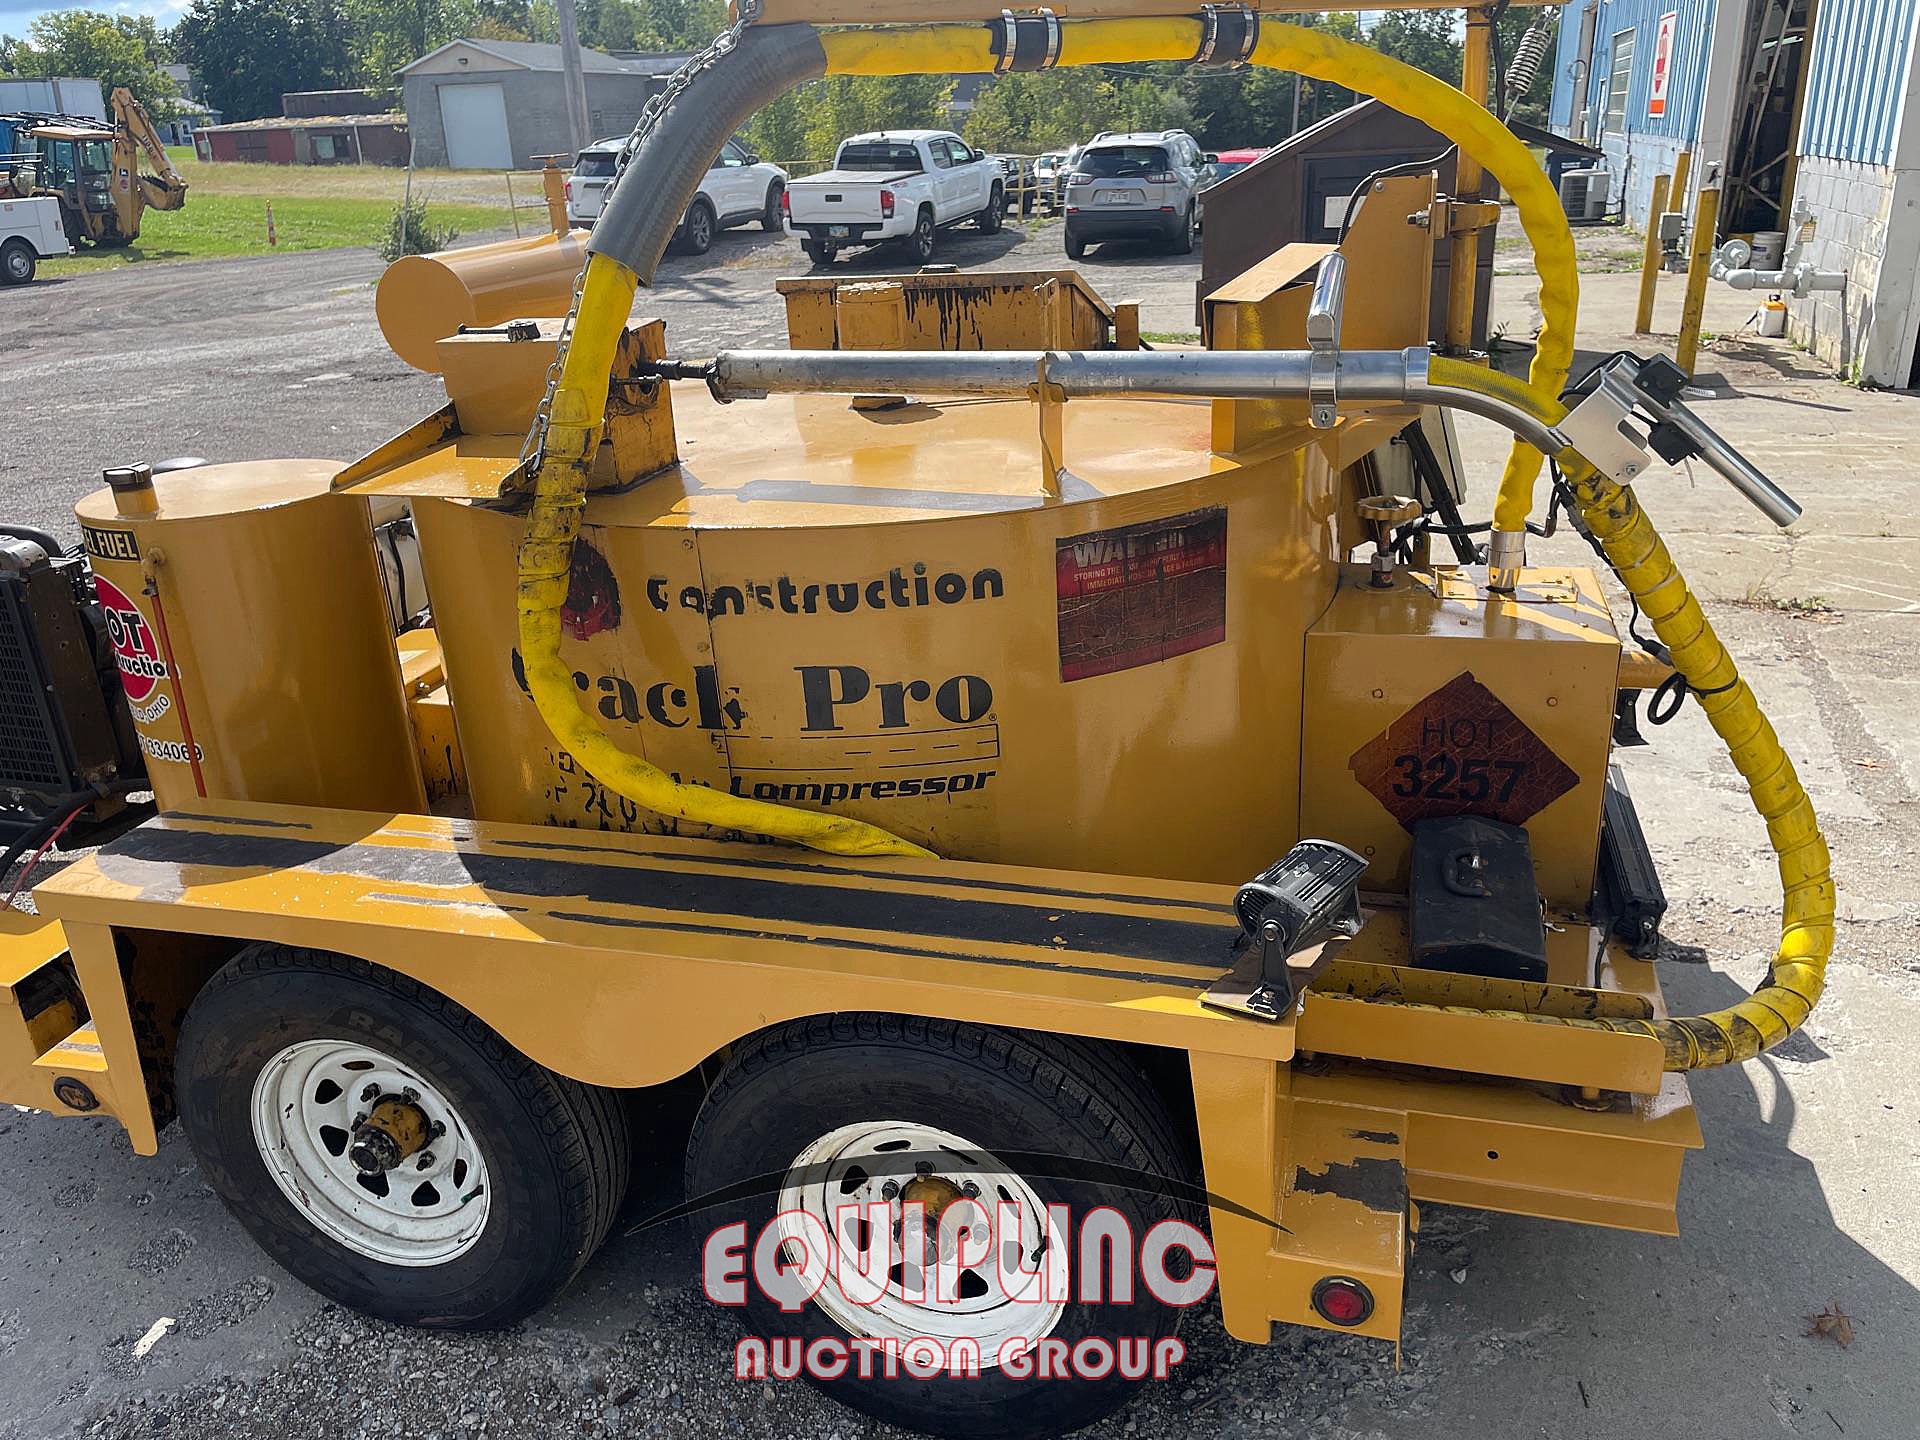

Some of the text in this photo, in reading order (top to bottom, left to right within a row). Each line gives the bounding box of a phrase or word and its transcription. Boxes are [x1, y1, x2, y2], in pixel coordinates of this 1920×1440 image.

[96, 532, 138, 558] FUEL
[148, 695, 170, 719] OHIO
[793, 665, 993, 731] Pro
[1422, 717, 1500, 749] HOT
[1391, 752, 1528, 803] 3257
